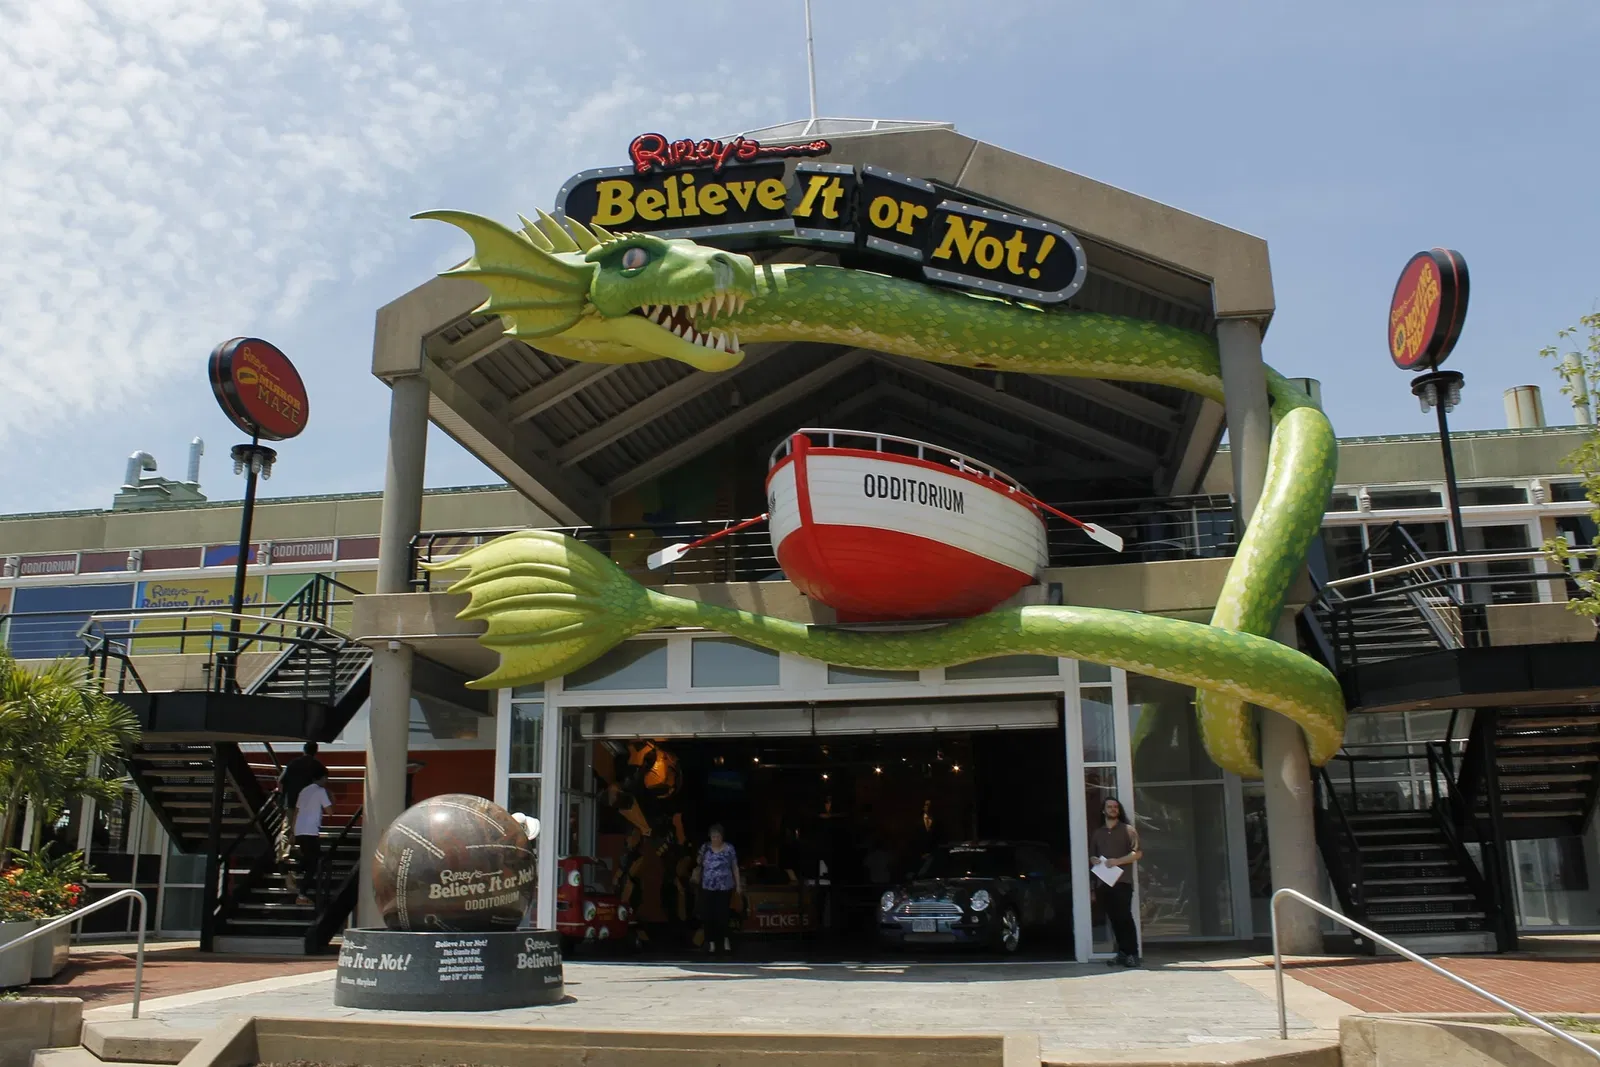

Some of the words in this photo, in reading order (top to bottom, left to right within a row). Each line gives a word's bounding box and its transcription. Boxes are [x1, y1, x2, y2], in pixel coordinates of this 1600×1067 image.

[591, 173, 787, 225] Believe
[792, 175, 844, 220] It
[869, 195, 929, 236] or
[932, 216, 1057, 280] Not!
[257, 385, 300, 425] MAZE
[863, 473, 965, 515] ODDITORIUM
[272, 542, 333, 558] ODDITORIUM
[20, 559, 75, 575] ODDITORIUM
[428, 882, 486, 899] Believe
[488, 875, 503, 892] It
[504, 875, 518, 889] or
[464, 890, 520, 911] ODDITORIUM
[755, 914, 809, 928] TICKETS
[352, 952, 364, 969] It
[364, 956, 379, 970] or
[378, 952, 412, 972] Not!
[516, 952, 553, 969] Believe
